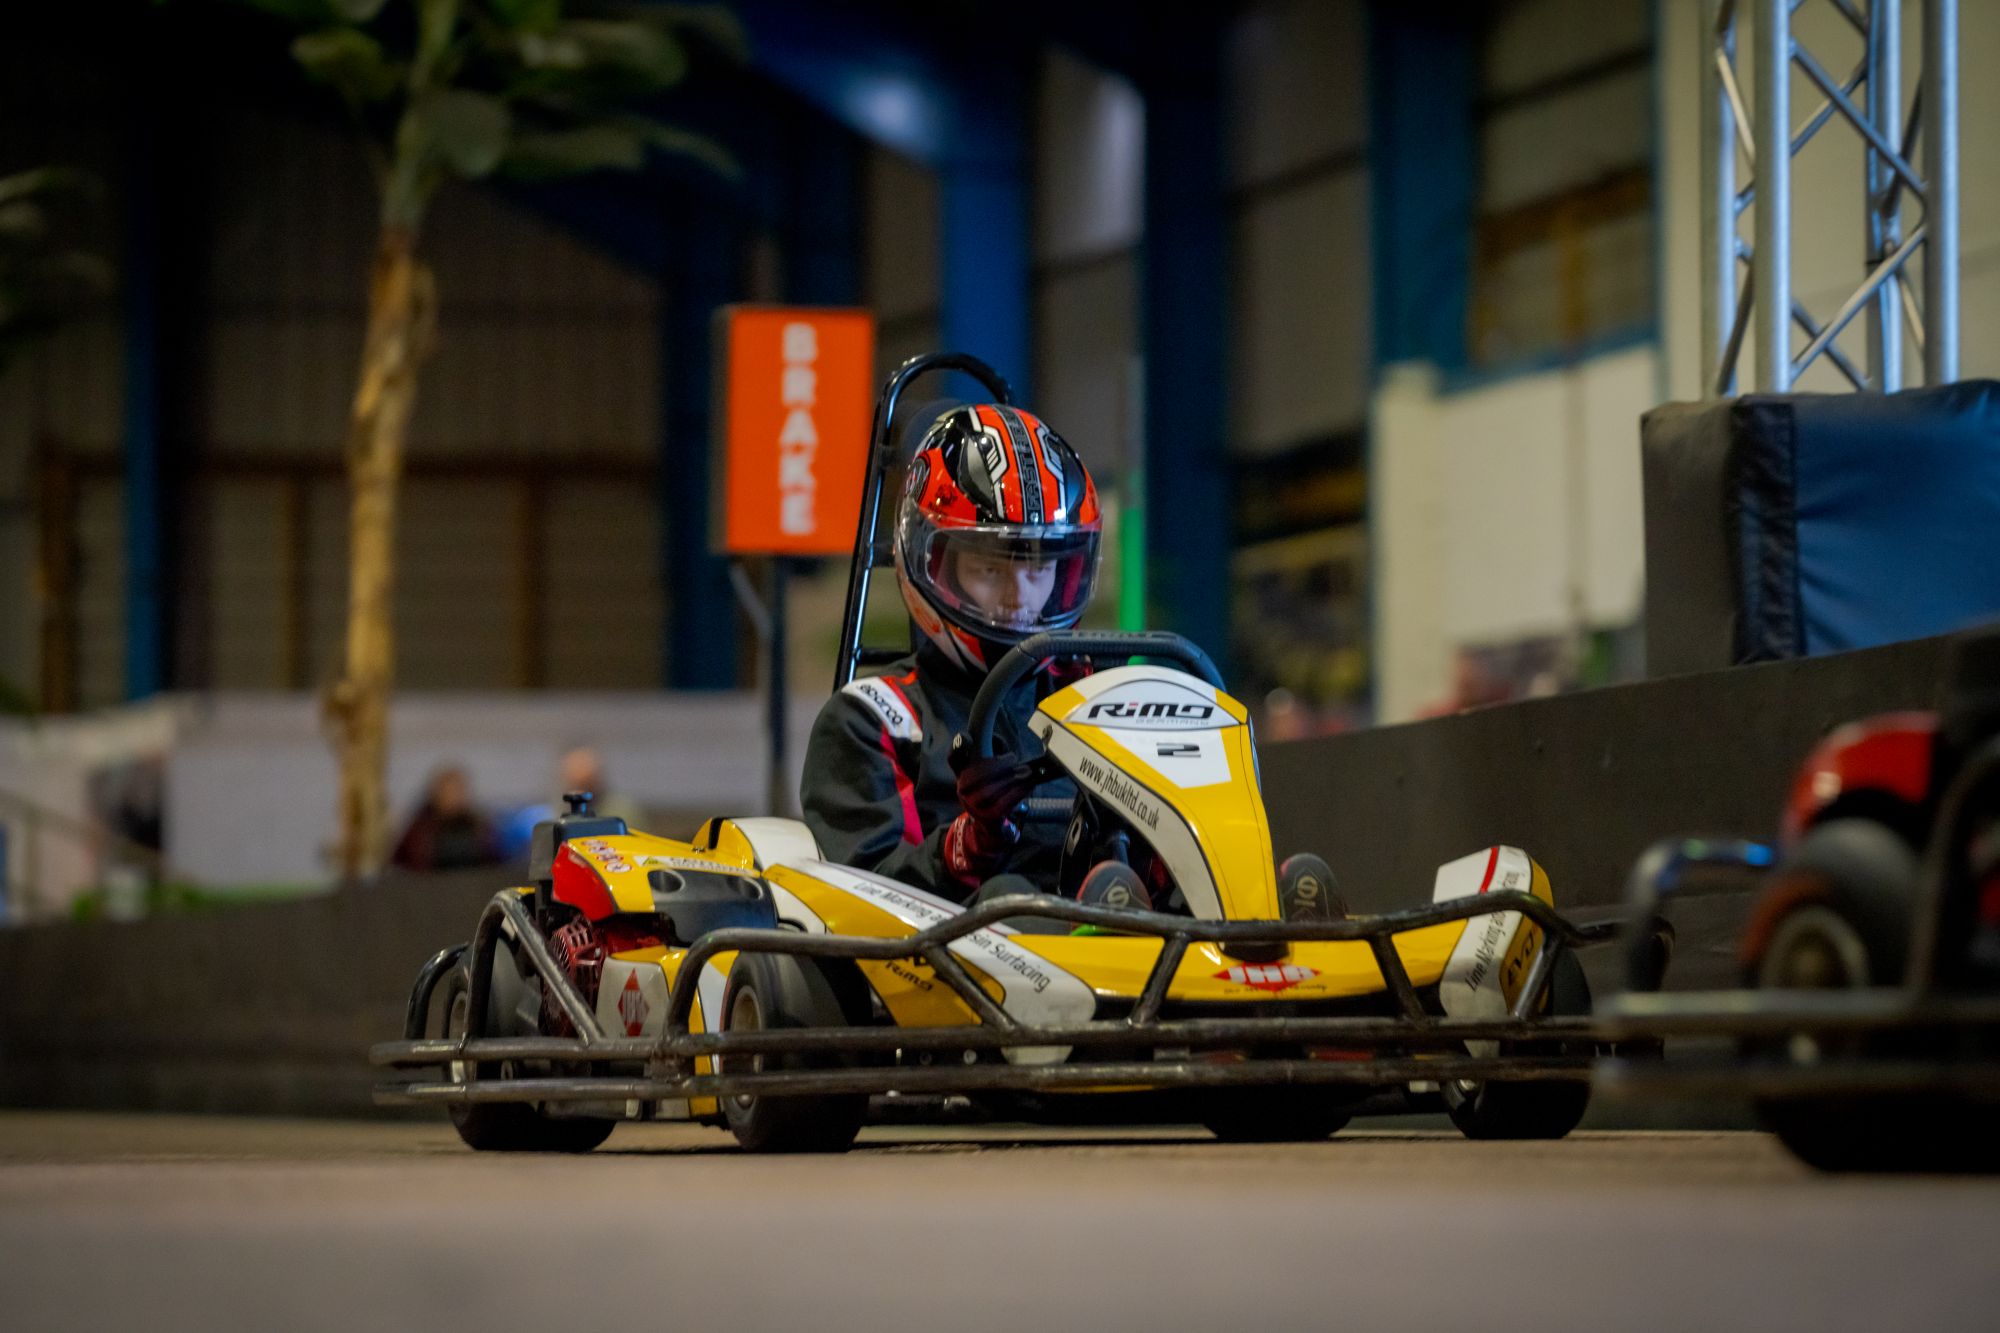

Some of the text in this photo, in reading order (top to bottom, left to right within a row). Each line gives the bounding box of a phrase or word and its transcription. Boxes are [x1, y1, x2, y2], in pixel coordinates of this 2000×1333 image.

[780, 322, 818, 536] BRAKE
[1156, 742, 1201, 759] 2
[989, 943, 1051, 993] Surfacing
[1464, 960, 1487, 992] Line
